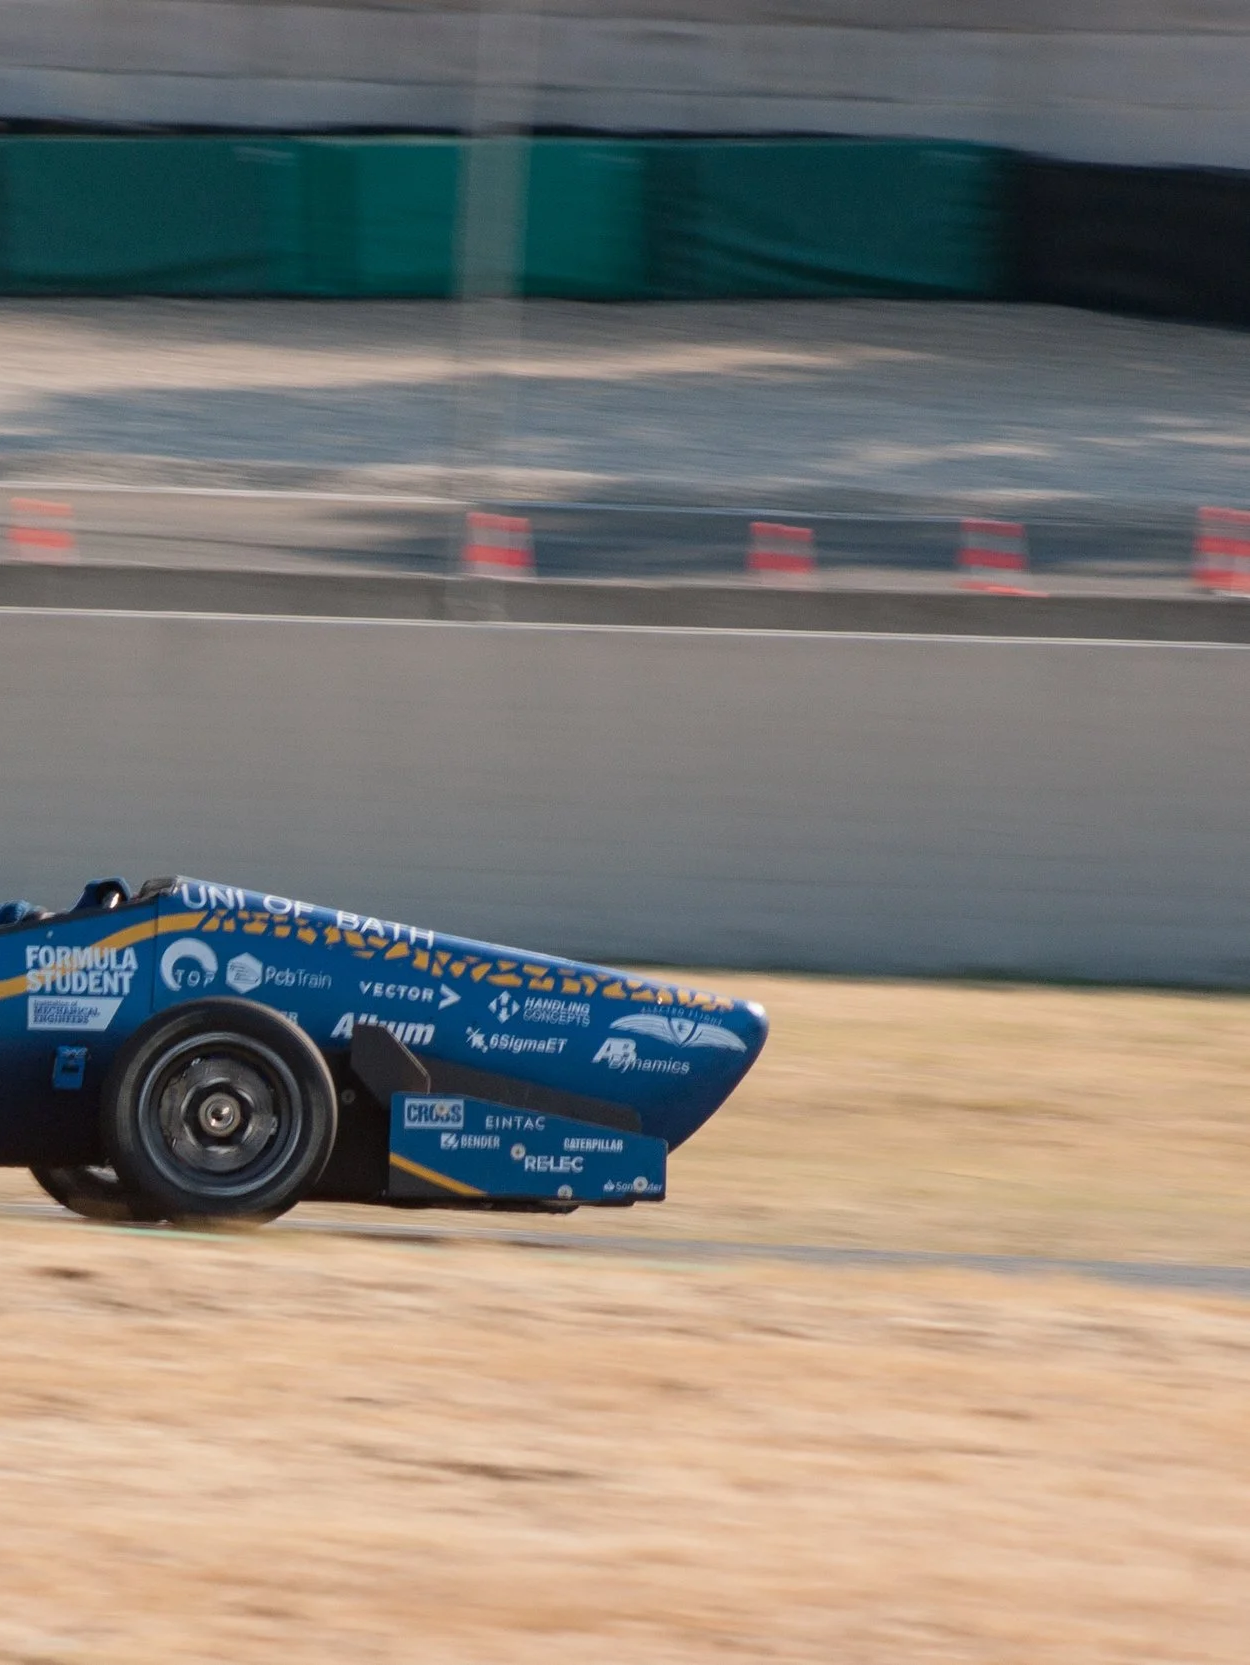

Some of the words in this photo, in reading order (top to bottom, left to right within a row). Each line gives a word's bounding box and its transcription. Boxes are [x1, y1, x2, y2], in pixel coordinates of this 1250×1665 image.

[181, 883, 246, 911] UNI
[263, 894, 315, 919] OF
[336, 909, 434, 950] BATH
[25, 944, 139, 971] FORMULA
[25, 968, 135, 996] STUDENT
[264, 965, 333, 990] PcbTrain
[358, 980, 435, 1004] VECTOR
[523, 996, 591, 1016] HANDLING
[522, 1008, 591, 1028] CONCEPTS
[489, 1033, 569, 1054] 6SigmaET
[485, 1115, 547, 1132] EINTAC
[460, 1134, 500, 1149] BENDER
[563, 1137, 624, 1153] CATERPILLAR
[524, 1154, 584, 1174] RELEC
